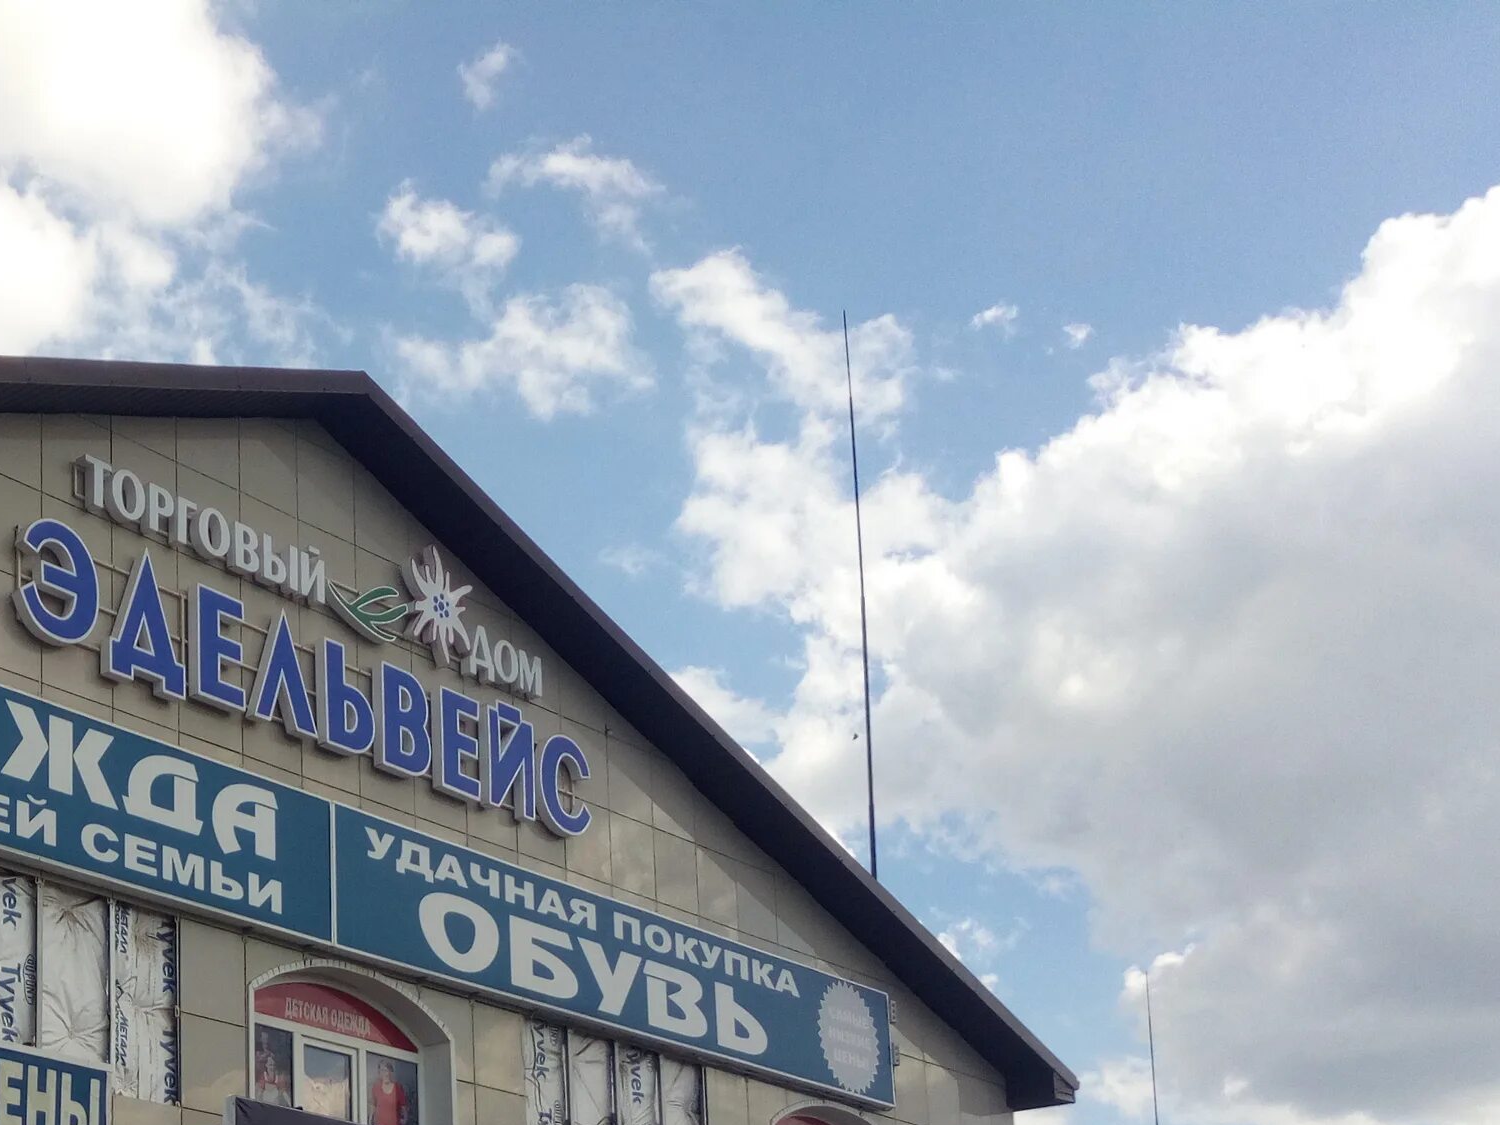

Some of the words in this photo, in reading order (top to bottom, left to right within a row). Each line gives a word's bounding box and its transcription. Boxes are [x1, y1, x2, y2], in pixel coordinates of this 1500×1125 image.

[74, 454, 327, 604] ТОРГОВЫЙ
[461, 625, 544, 699] ДОМ
[13, 519, 591, 838] ЭДЕЛЬВЕЙС
[80, 823, 283, 915] СЕМЬИ
[364, 826, 597, 931] УДАЧНАЯ
[613, 911, 801, 998] ПОКУПКА
[284, 997, 329, 1024] ДЕТСКАЯ
[331, 1008, 371, 1037] ОДЕЖДА
[418, 892, 768, 1057] ОБУВЬ
